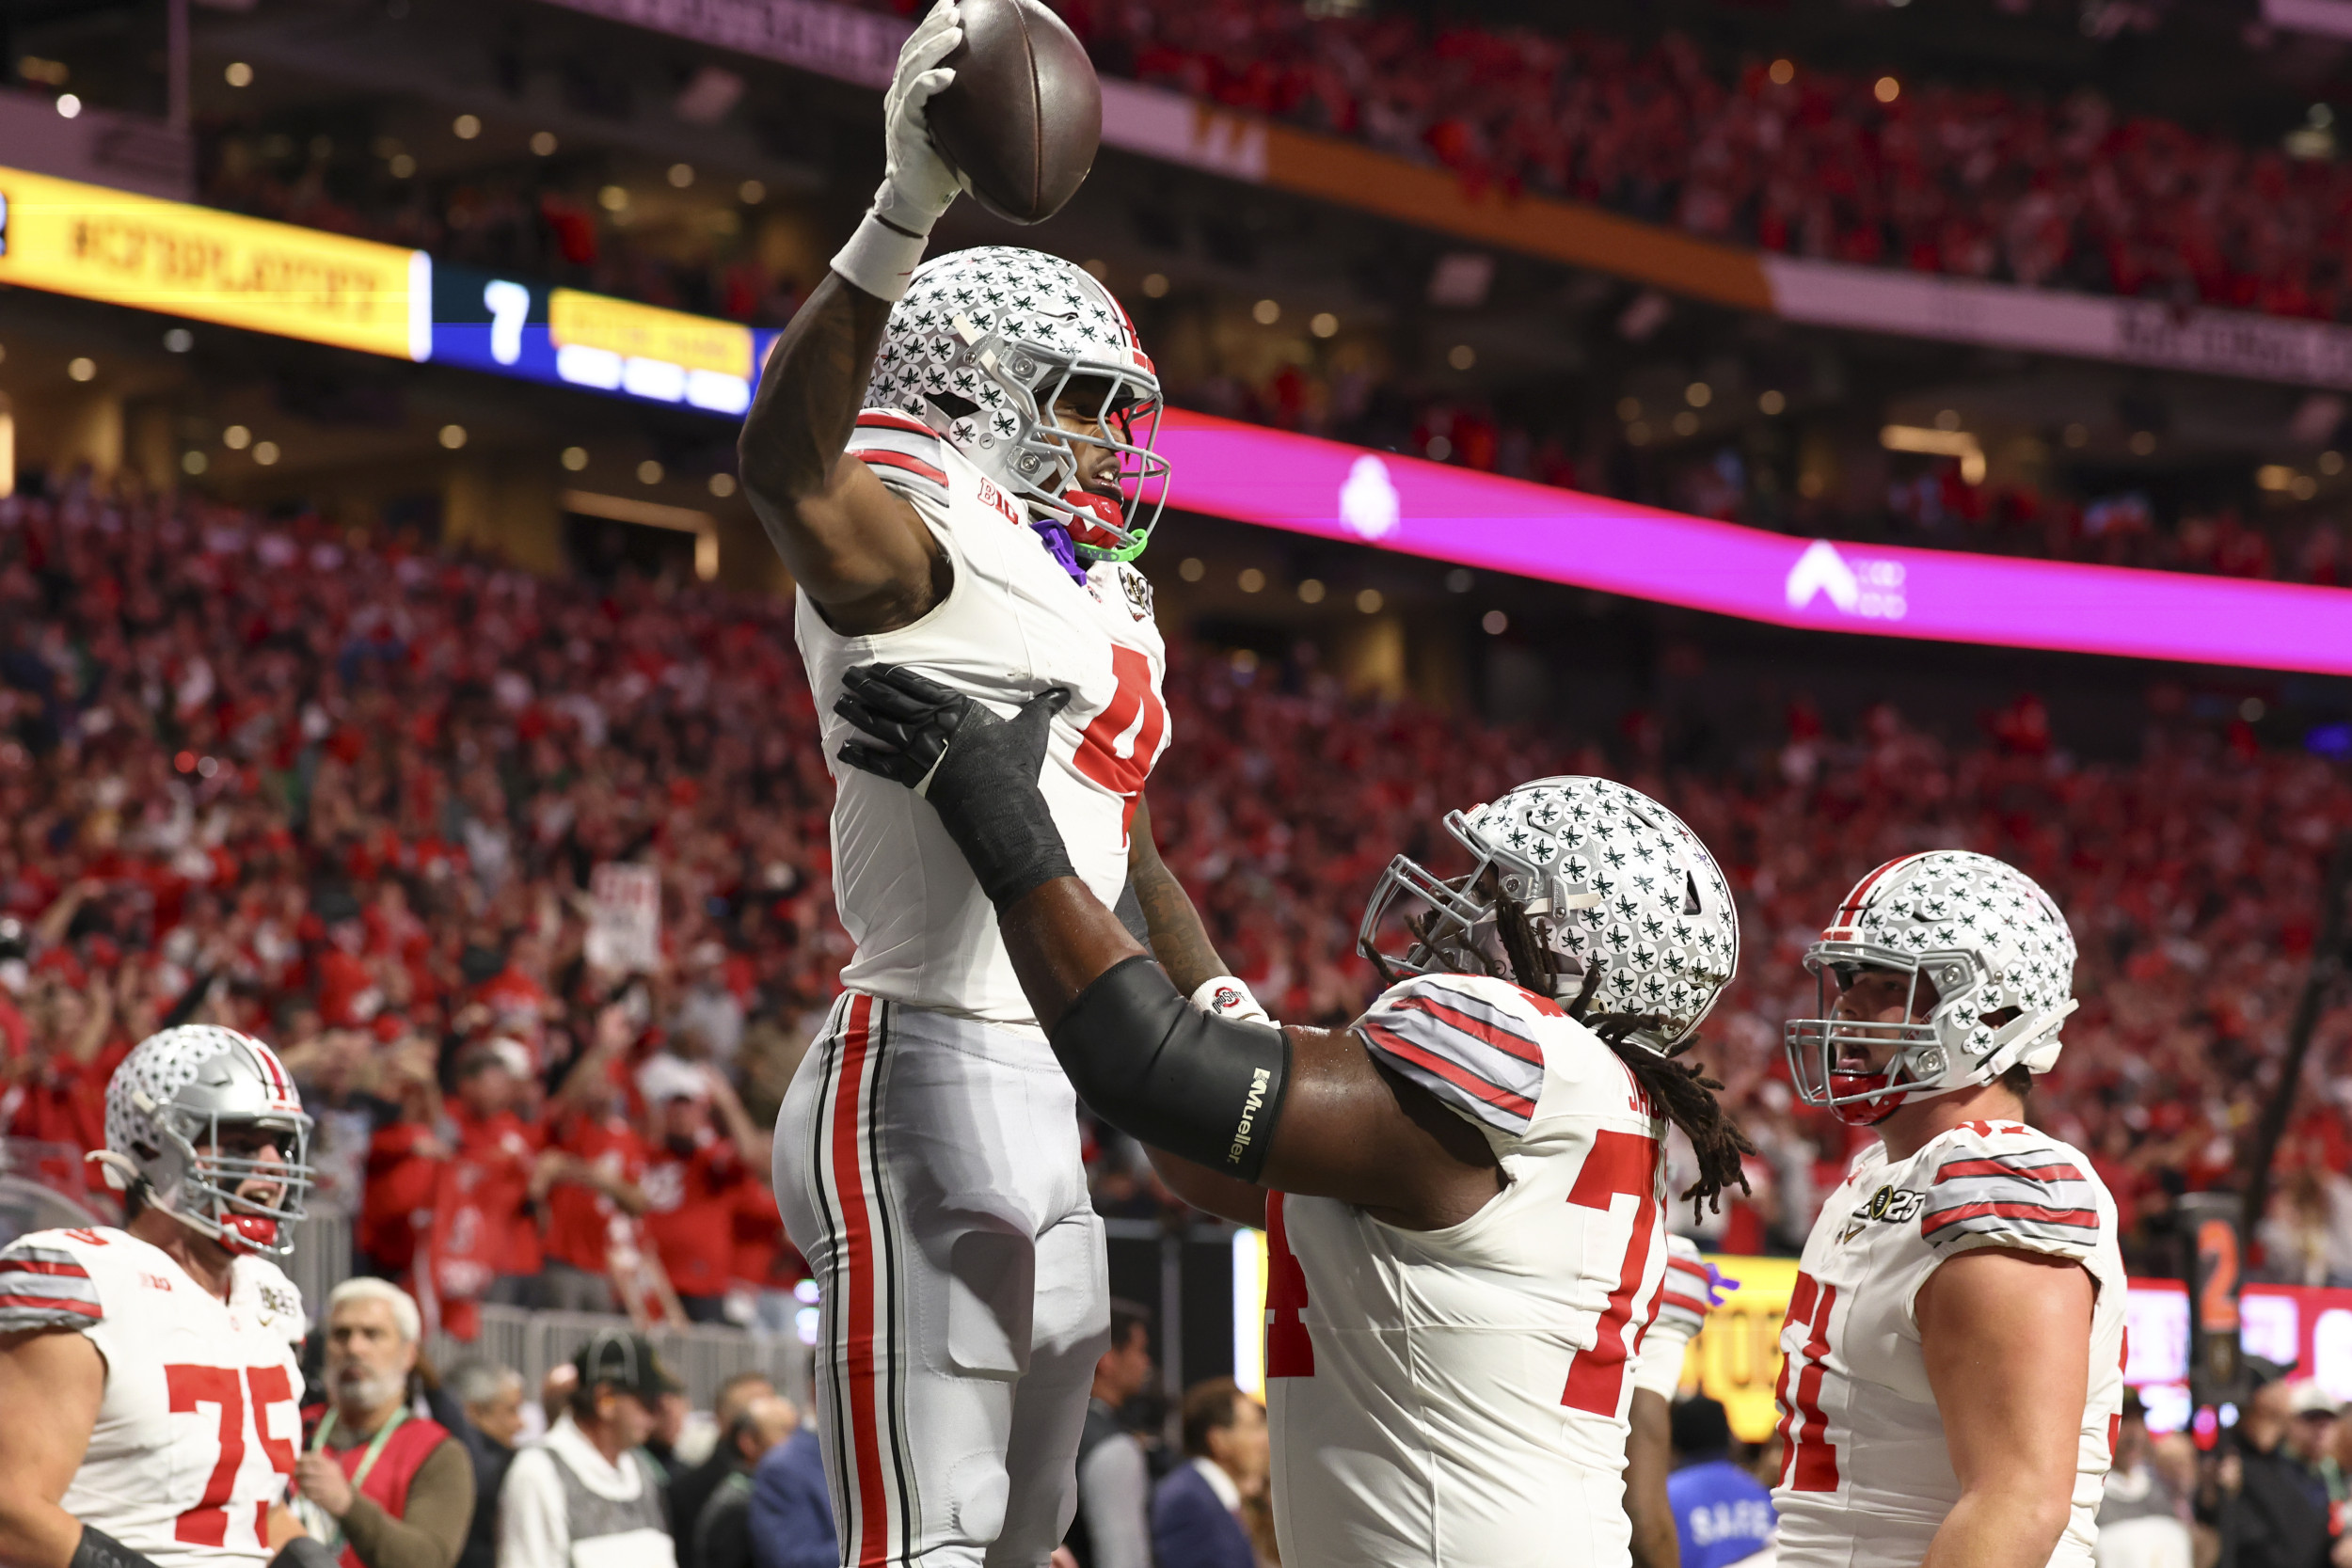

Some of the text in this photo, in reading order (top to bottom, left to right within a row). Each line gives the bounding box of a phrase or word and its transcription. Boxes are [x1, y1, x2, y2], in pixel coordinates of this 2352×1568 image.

[483, 279, 530, 365] 7
[1229, 1082, 1267, 1164] Mueller
[2198, 1218, 2239, 1333] 2
[162, 1362, 296, 1550] 75
